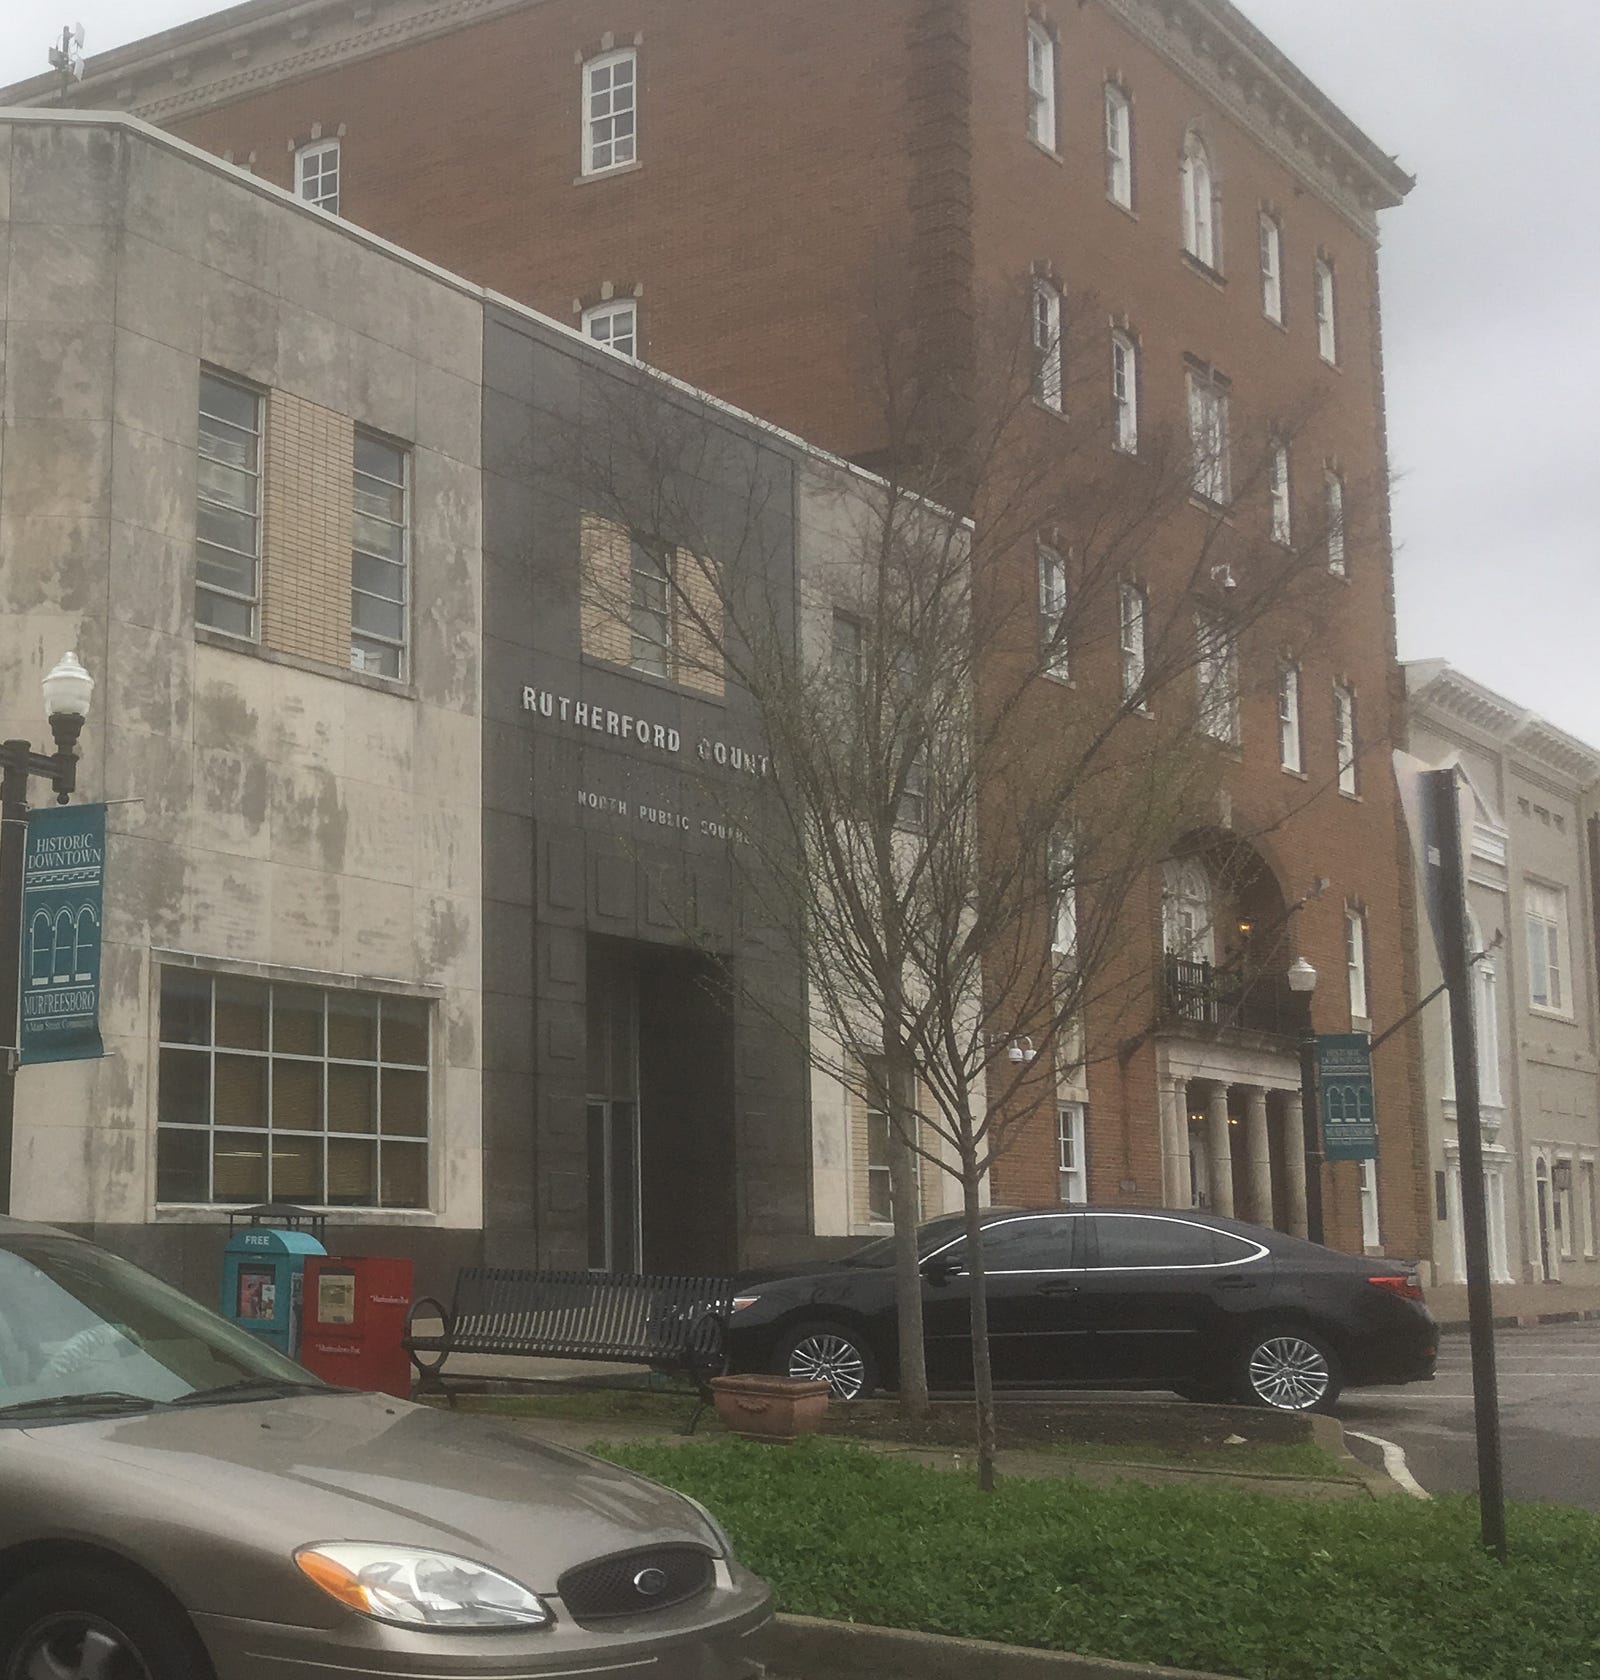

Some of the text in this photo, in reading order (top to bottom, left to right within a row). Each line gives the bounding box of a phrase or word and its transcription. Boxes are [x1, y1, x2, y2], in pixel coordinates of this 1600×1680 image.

[522, 685, 780, 780] RUTHERFORD COUNT
[577, 789, 627, 815] NORTH
[639, 804, 690, 830] PUBLIC
[36, 832, 94, 853] HISTORIC
[28, 848, 101, 869] DOWNTOWN
[23, 990, 95, 1016] MURFREESBORO
[244, 1235, 270, 1246] FREE
